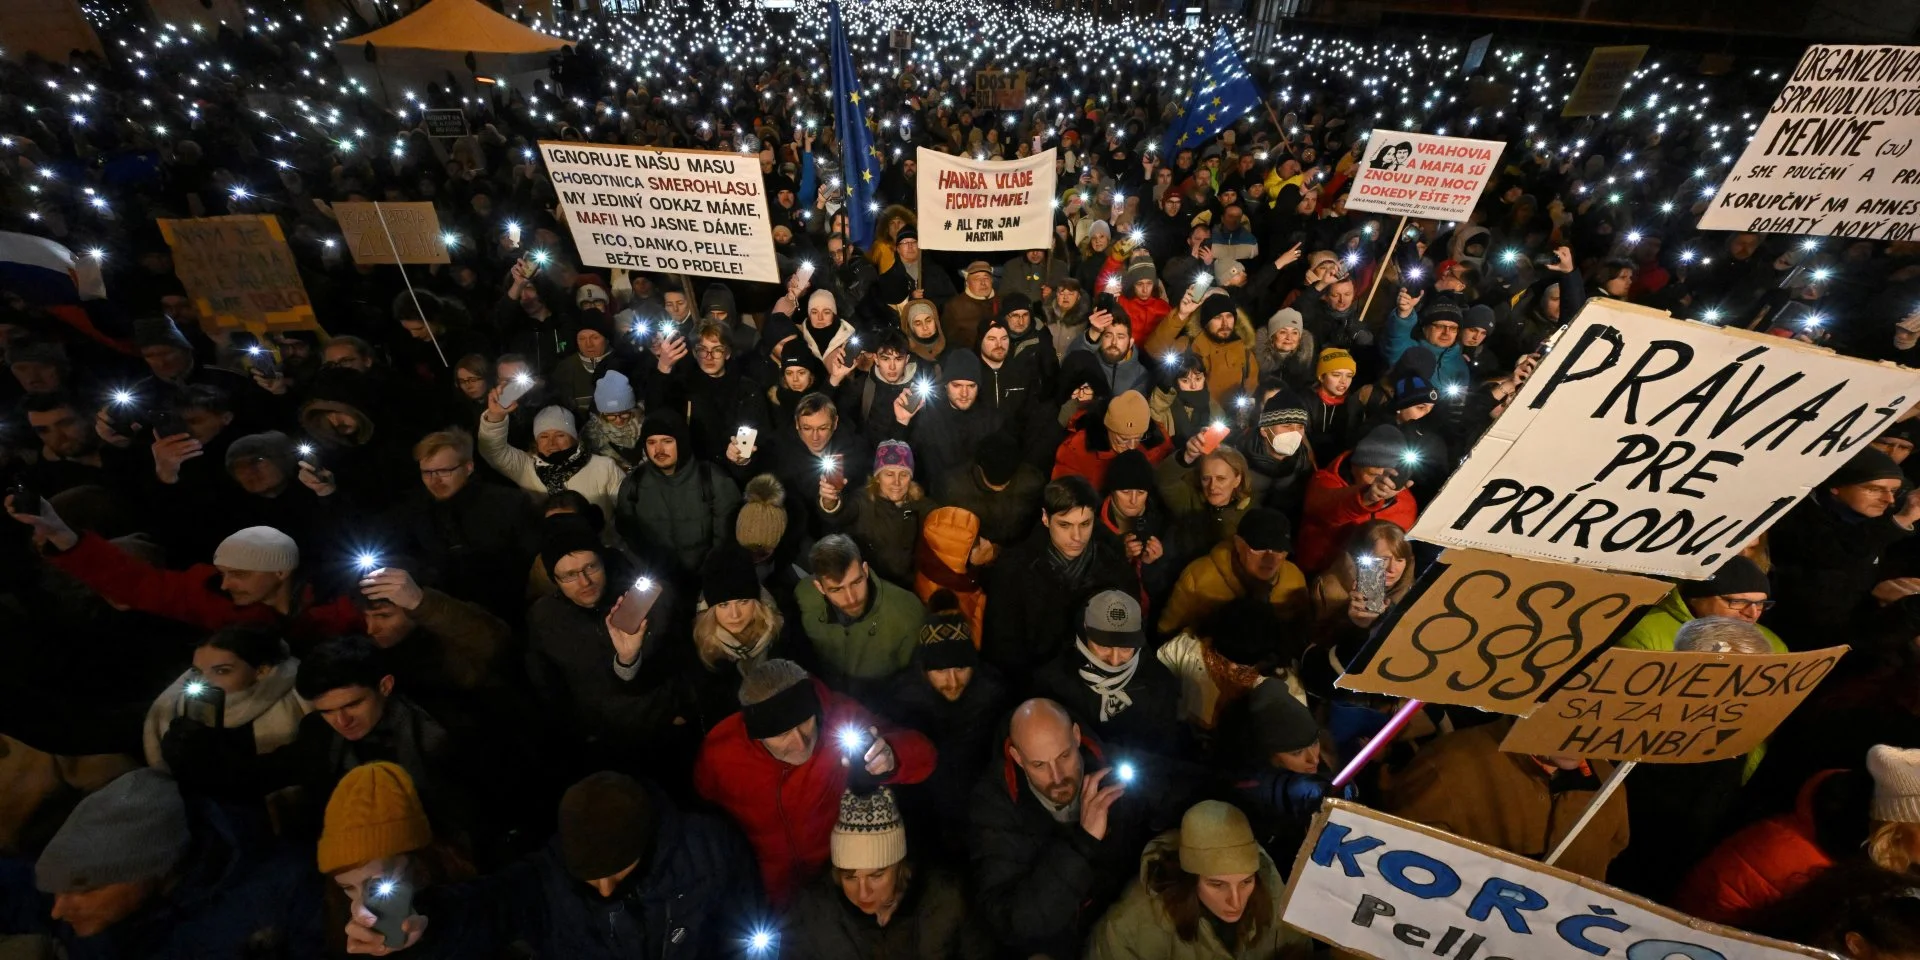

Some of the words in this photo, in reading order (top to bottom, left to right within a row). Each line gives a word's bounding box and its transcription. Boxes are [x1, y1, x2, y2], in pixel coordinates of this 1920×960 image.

[1764, 116, 1885, 156] MENÍME
[1875, 139, 1912, 158] (JU)
[548, 149, 631, 168] IGNORUJE
[635, 151, 680, 171] NAŠU
[687, 158, 734, 174] MASU
[1418, 143, 1492, 160] VRAHOVIA
[938, 170, 988, 190] HANBA
[996, 168, 1033, 190] VLÁDE
[1406, 159, 1416, 169] A
[1420, 160, 1464, 174] MAFIA
[1468, 163, 1486, 176] SÚ
[1748, 165, 1778, 178] SME
[1783, 163, 1854, 180] POUČENÍ
[1858, 168, 1875, 182] A
[552, 172, 644, 188] CHOBOTNICA
[648, 176, 760, 196] SMEROHLASU.
[1364, 170, 1413, 184] ZNOVU
[1415, 176, 1438, 187] PRI
[1441, 178, 1478, 191] MOCI
[563, 192, 586, 204] MY
[592, 192, 642, 208] JEDINÝ
[650, 197, 703, 212] ODKAZ
[706, 201, 761, 219] MÁME,
[946, 193, 988, 210] FICOVEJ
[990, 192, 1029, 208] MAFIE!
[1360, 185, 1417, 200] DOKEDY
[1419, 190, 1449, 204] EŠTE
[1452, 195, 1472, 206] ???
[1720, 192, 1822, 211] KORUPČNÝ
[1820, 197, 1849, 212] NA
[1856, 198, 1920, 216] AMNES
[576, 211, 618, 226] MAFII
[622, 215, 645, 228] HO
[651, 217, 699, 232] JASNE
[703, 218, 752, 236] DÁME:
[956, 219, 972, 230] ALL
[976, 219, 994, 230] FOR
[998, 216, 1020, 228] JAN
[1748, 214, 1827, 233] BOHATÝ
[1830, 218, 1890, 238] NOVÝ
[1882, 222, 1920, 240] ROK
[592, 232, 632, 249] FICO,
[634, 236, 692, 254] DANKO,
[694, 242, 749, 258] PELLE...
[966, 230, 1004, 242] MARTINA
[606, 252, 650, 268] BEŽTE
[656, 257, 678, 270] DO
[682, 259, 743, 274] PRDELE!
[1528, 324, 1850, 451] PRÁVA
[1594, 434, 1744, 498] PRE
[1450, 478, 1796, 566] PRÍRODU!
[1560, 656, 1836, 698] SLOVENSKO
[1558, 698, 1602, 720] SA
[1613, 702, 1662, 722] ZA
[1681, 700, 1748, 723] VÁS
[1558, 725, 1742, 757] HANBÍ!
[1352, 894, 1516, 960] Pell
